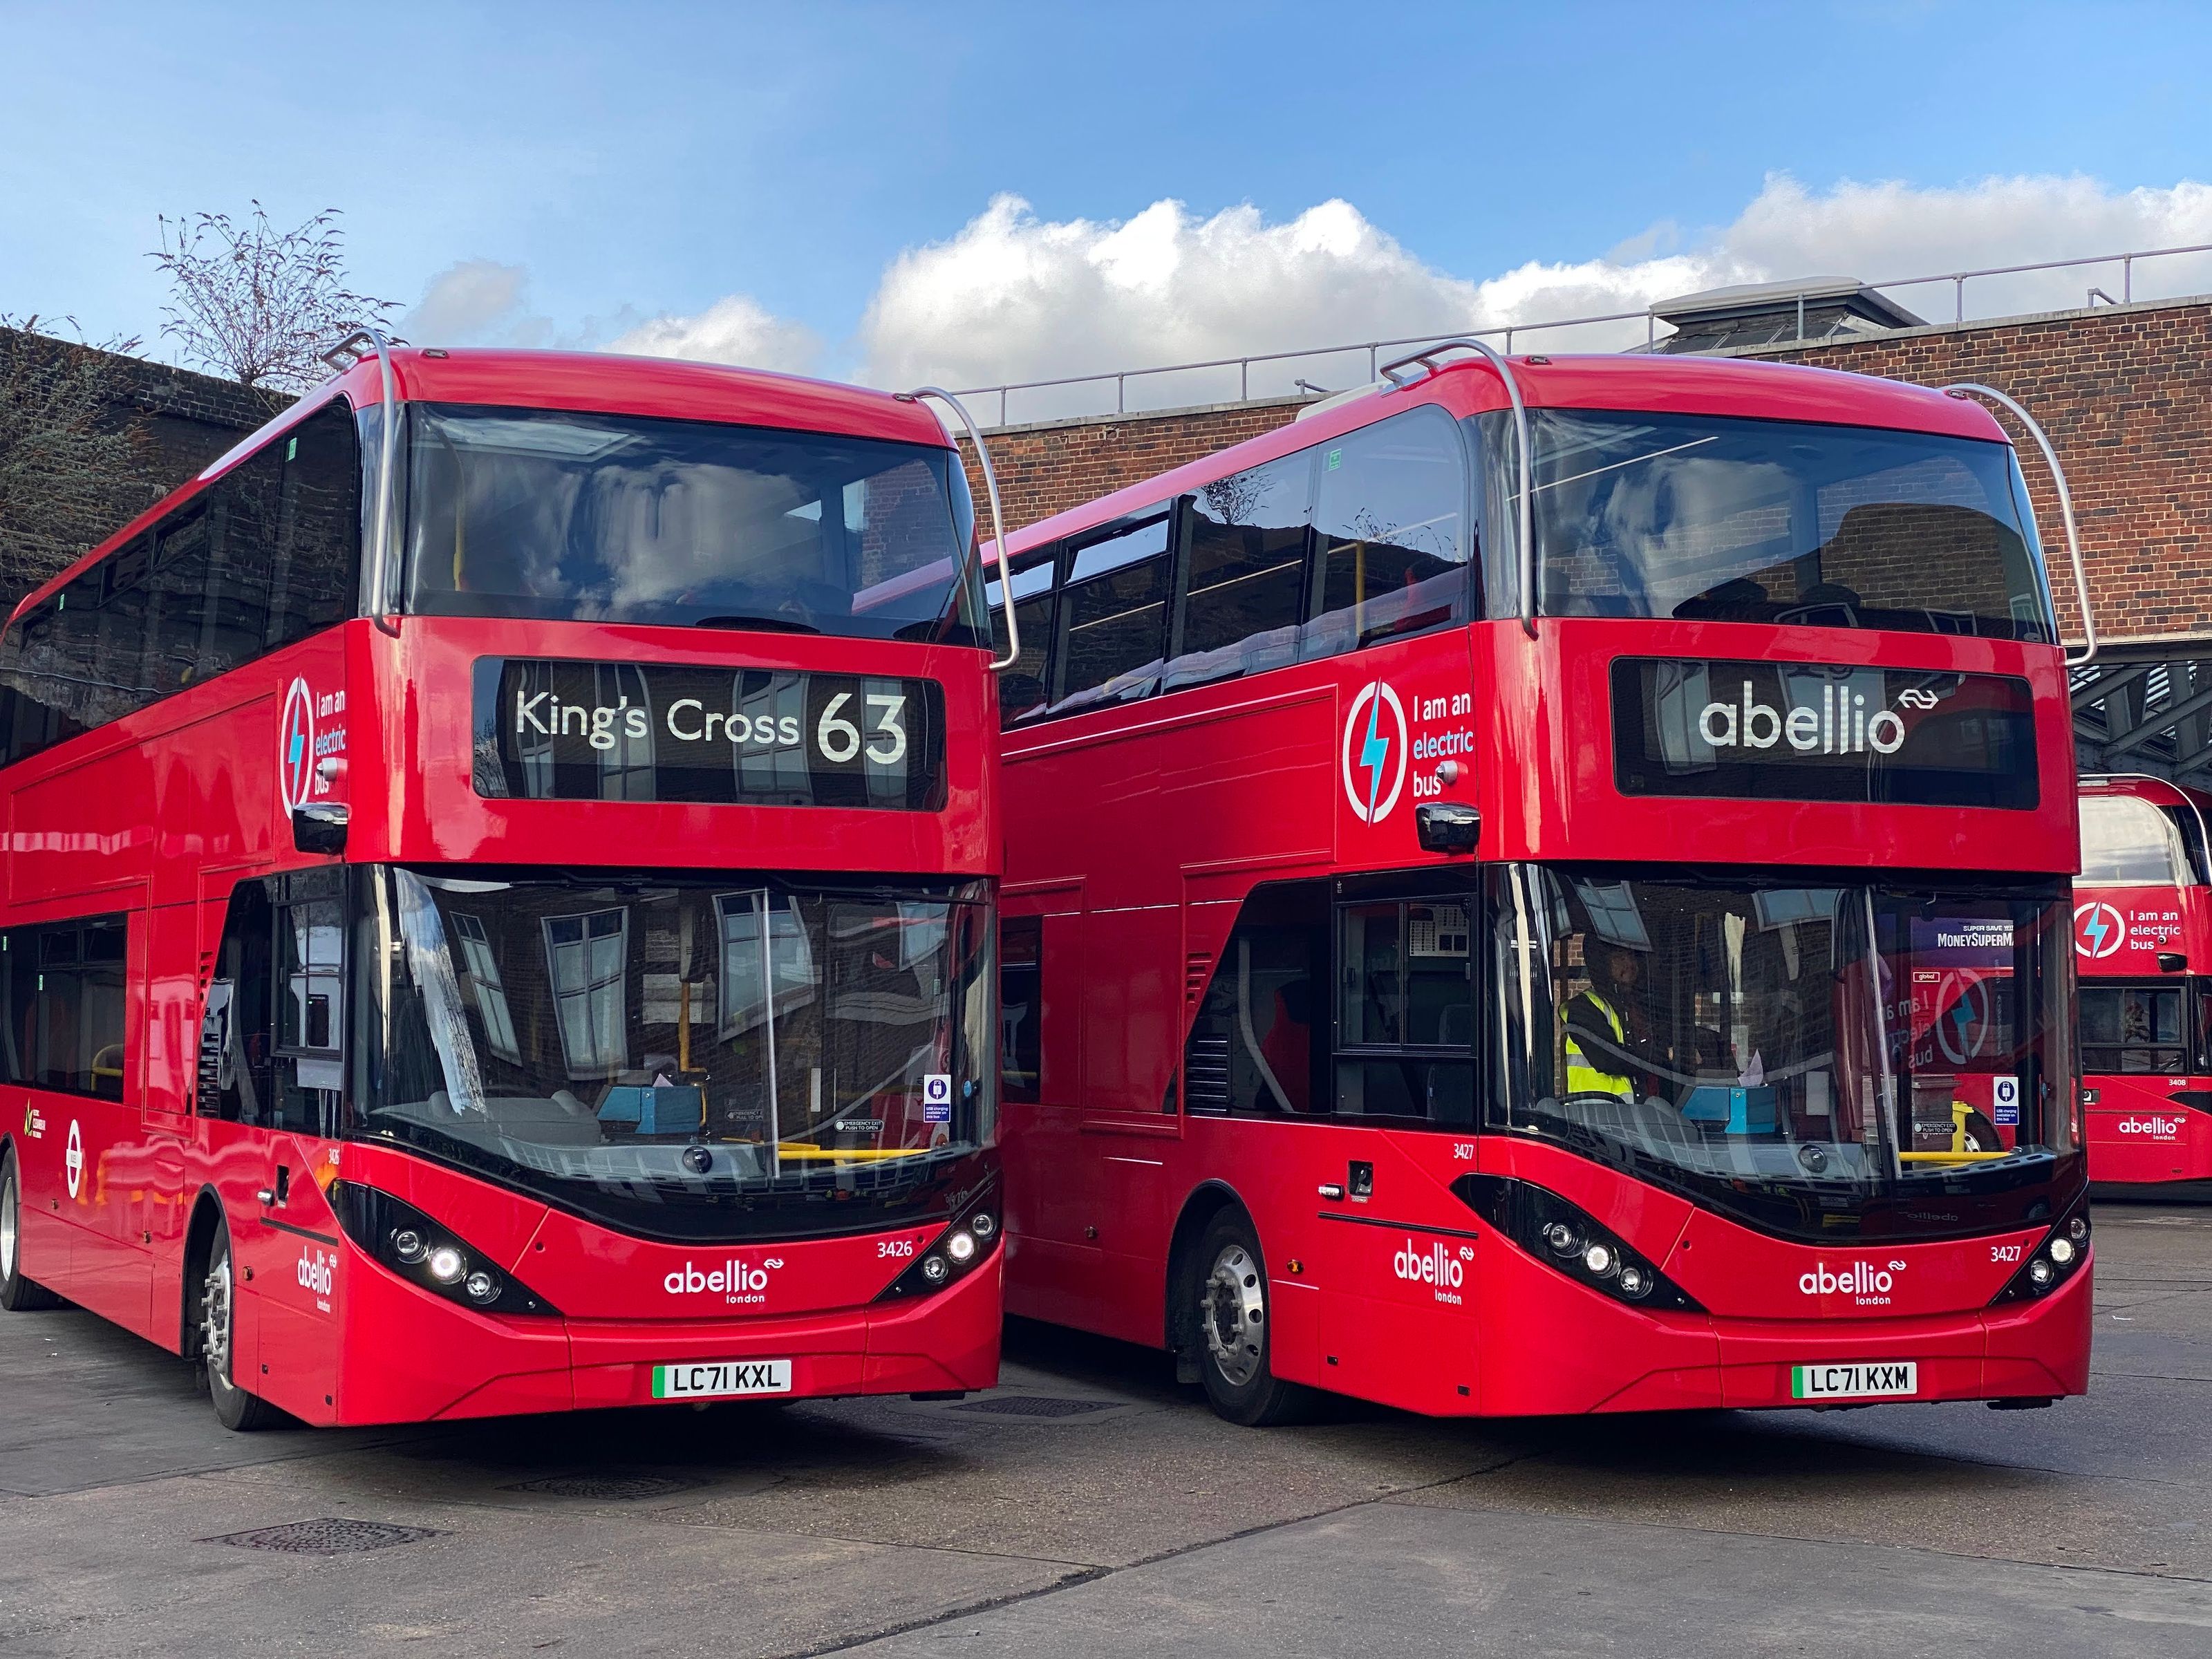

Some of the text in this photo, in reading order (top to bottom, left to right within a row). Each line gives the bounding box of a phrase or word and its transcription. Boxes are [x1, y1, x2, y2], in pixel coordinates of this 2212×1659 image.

[317, 690, 346, 718] I am an
[1414, 693, 1471, 722] I am an
[516, 691, 907, 765] King's Cross 63
[1699, 681, 1905, 754] abellio
[315, 723, 346, 757] electric
[1413, 725, 1474, 760] electric
[1413, 771, 1441, 797] bus
[2130, 910, 2178, 921] I am an
[1938, 932, 2014, 947] MONEYSUPERM
[2130, 924, 2180, 935] electric
[2130, 939, 2155, 950] bus
[2119, 1117, 2177, 1134] abellio
[1454, 1143, 1474, 1160] 3427
[877, 1241, 912, 1258] 3426
[1990, 1246, 2021, 1262] 3427
[298, 1246, 331, 1295] abellio
[664, 1260, 768, 1293] abellio
[1394, 1239, 1463, 1288] abellio
[1799, 1262, 1893, 1295] abellio
[317, 1297, 330, 1313] london
[726, 1294, 765, 1304] london
[1435, 1289, 1461, 1305] london
[1856, 1295, 1891, 1305] london
[674, 1364, 781, 1391] LC71 KXL
[1811, 1366, 1908, 1392] LC71 KXM
